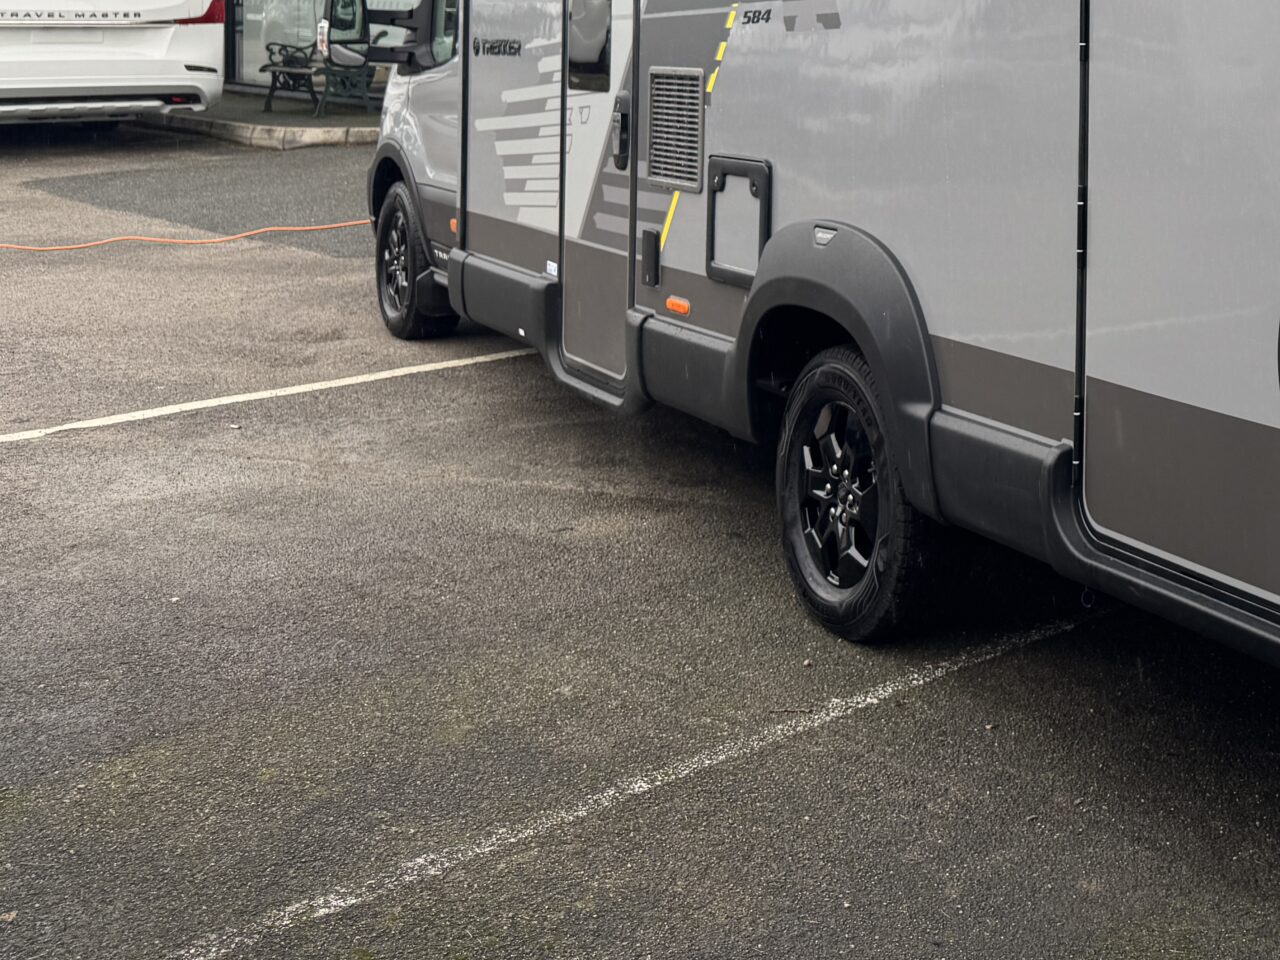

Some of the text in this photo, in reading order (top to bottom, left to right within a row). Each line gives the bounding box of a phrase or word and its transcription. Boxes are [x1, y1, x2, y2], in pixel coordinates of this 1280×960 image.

[0, 11, 141, 19] TRAVEL MASTER
[741, 8, 772, 25] 584
[481, 38, 522, 57] TREKKER
